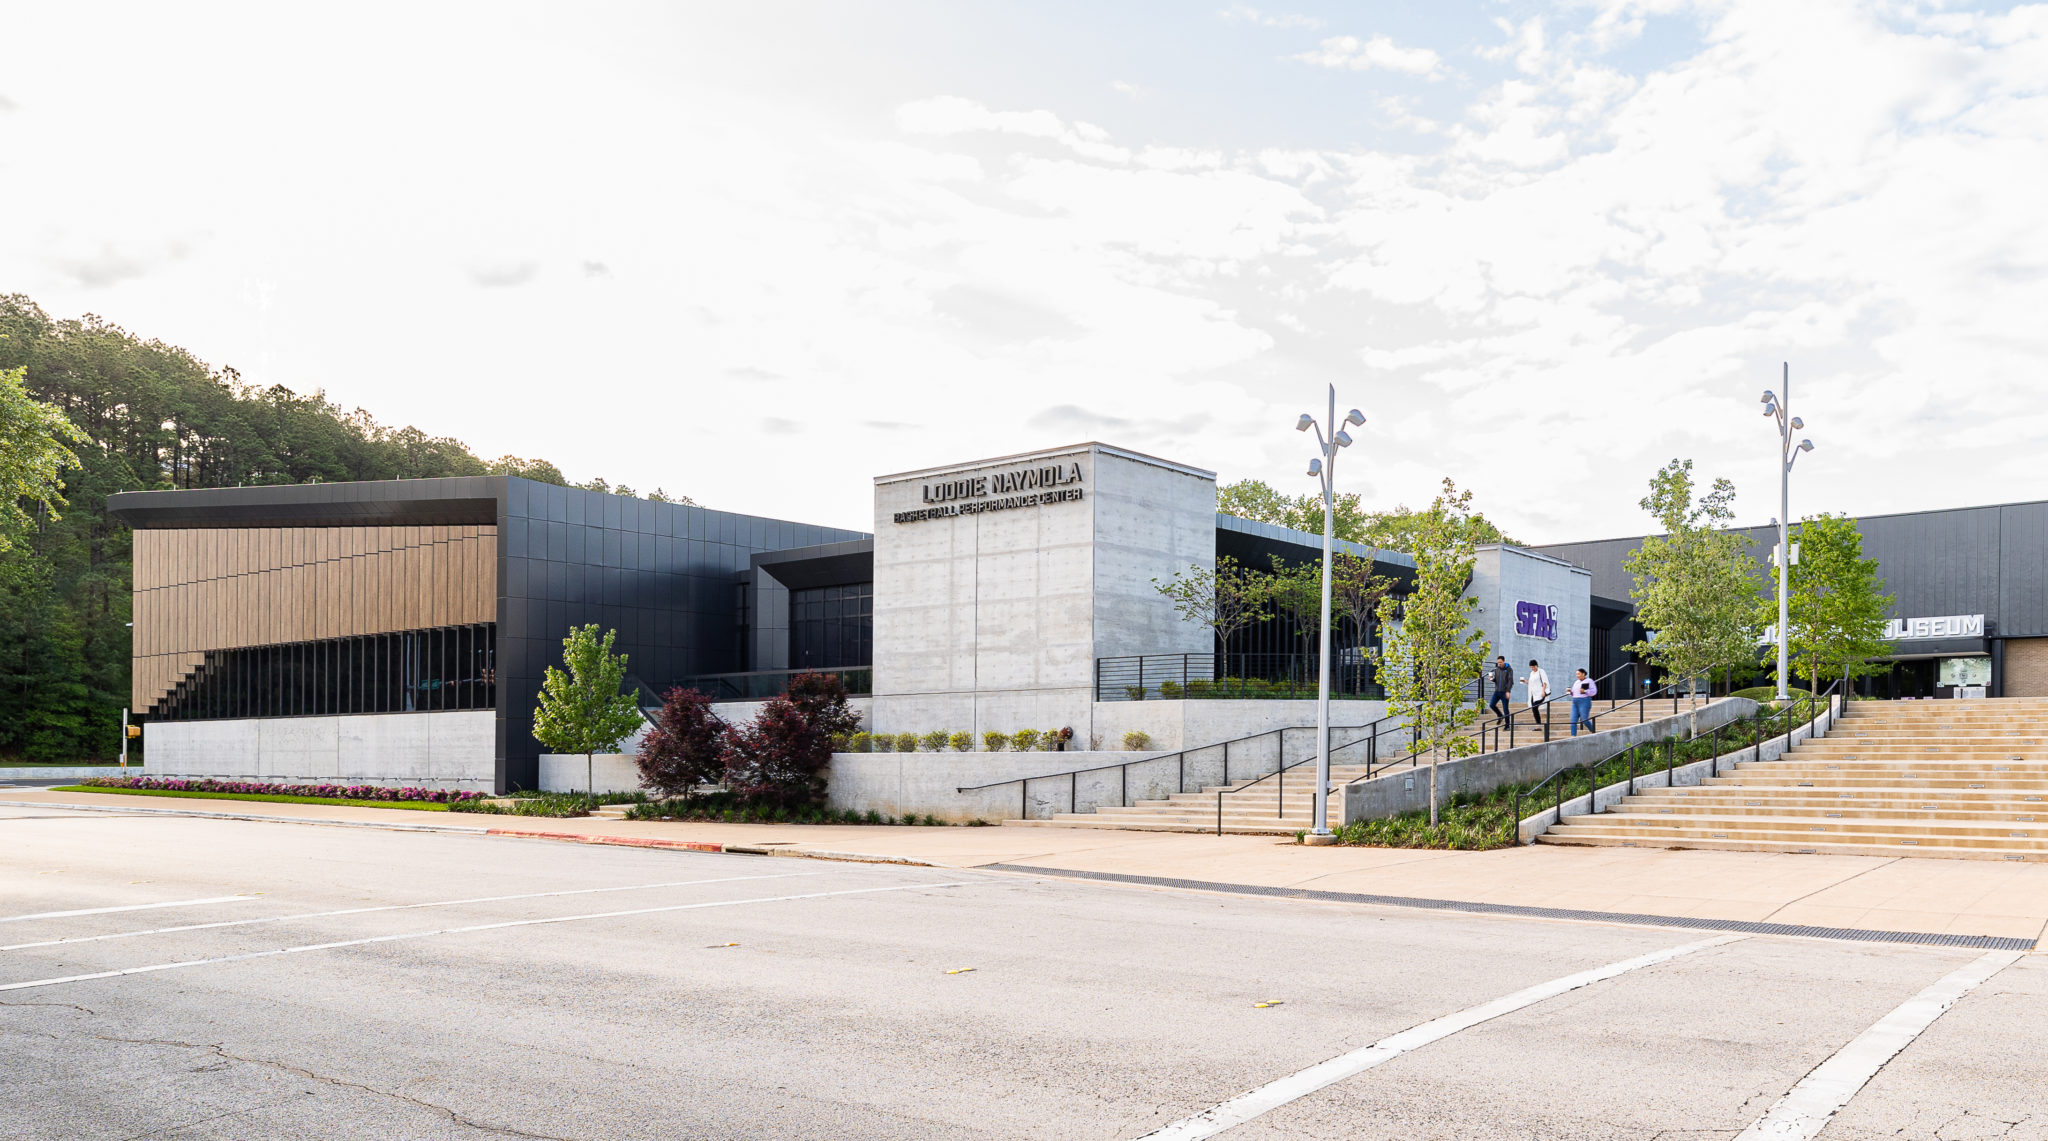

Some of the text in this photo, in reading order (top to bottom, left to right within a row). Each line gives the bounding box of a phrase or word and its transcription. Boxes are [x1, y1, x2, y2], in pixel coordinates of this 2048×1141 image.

[922, 462, 1083, 503] LODDIE NAYMOLA
[893, 487, 1083, 524] BASKETBALL PERFORMANCE CENTER
[1881, 614, 1982, 638] LISEUM
